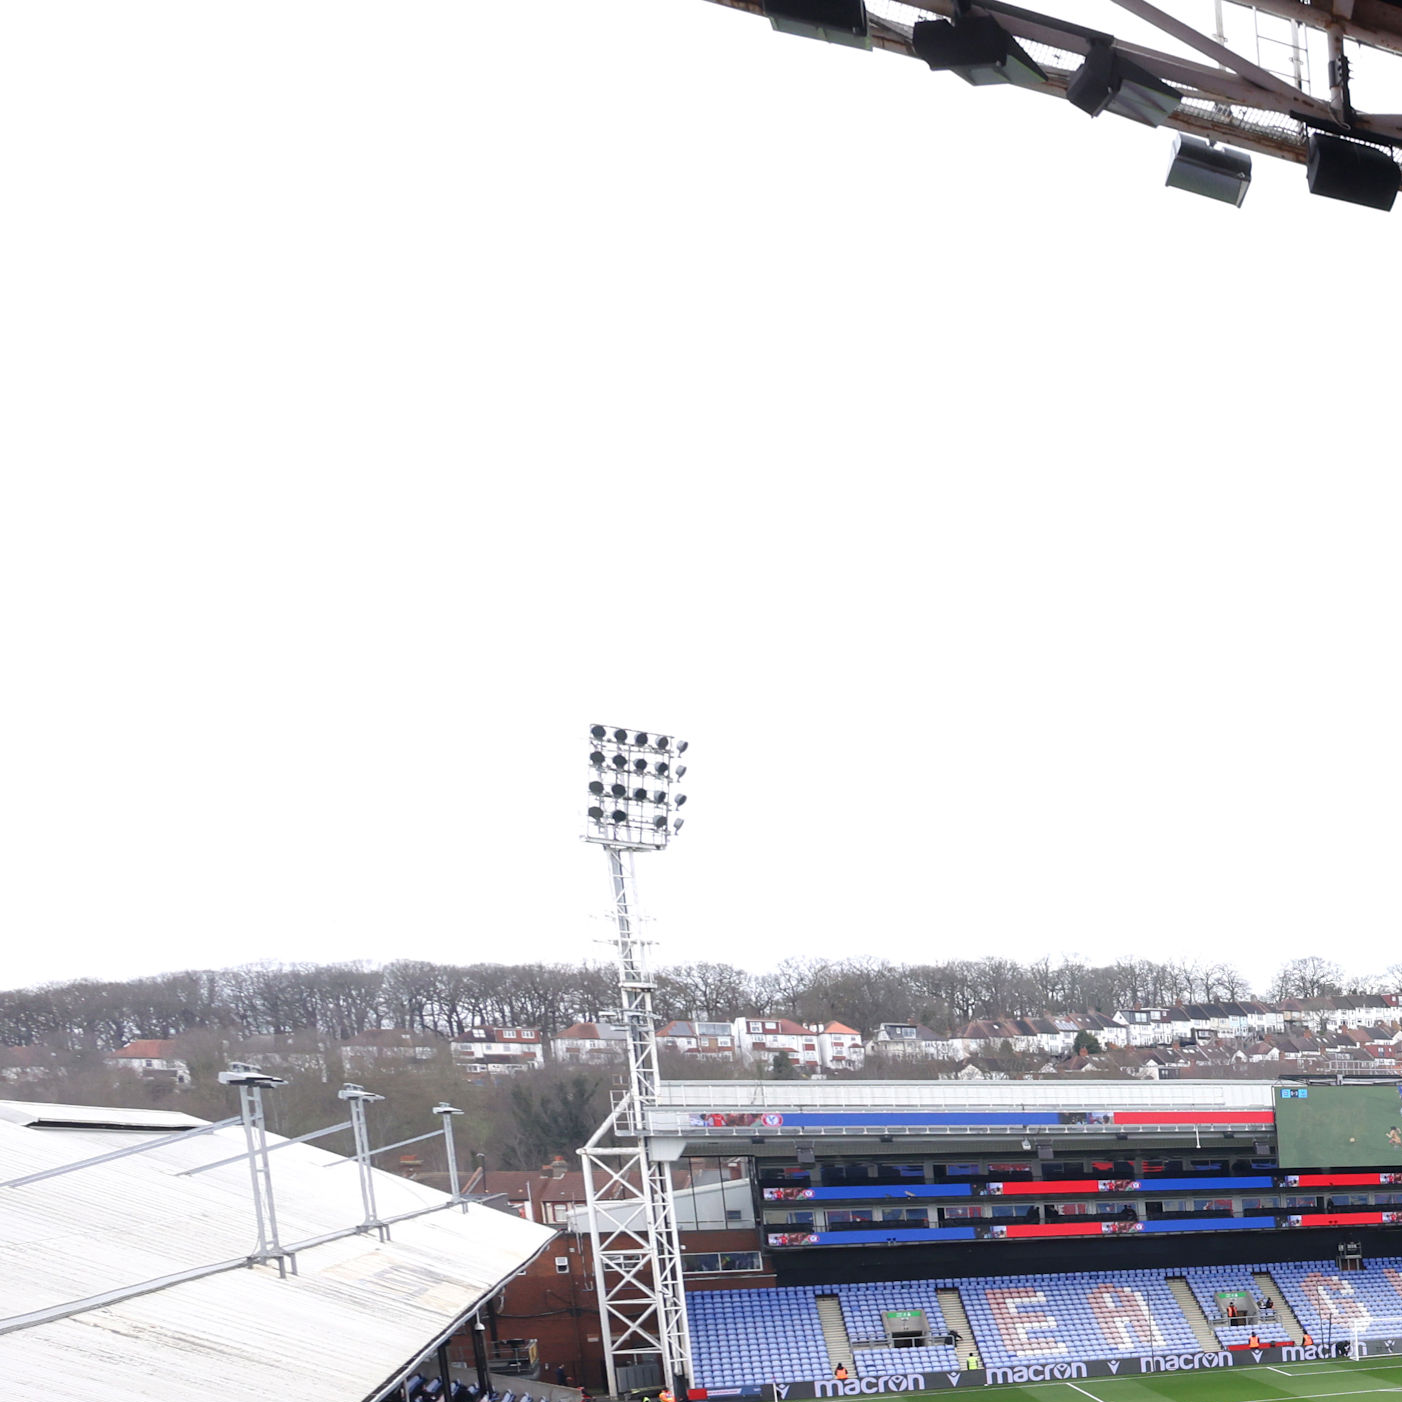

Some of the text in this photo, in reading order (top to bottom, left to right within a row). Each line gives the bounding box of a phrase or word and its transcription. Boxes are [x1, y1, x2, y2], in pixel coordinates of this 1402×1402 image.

[1140, 1350, 1233, 1373] macron
[1282, 1340, 1367, 1362] macrn
[986, 1362, 1087, 1385] macron
[814, 1373, 925, 1398] macron
